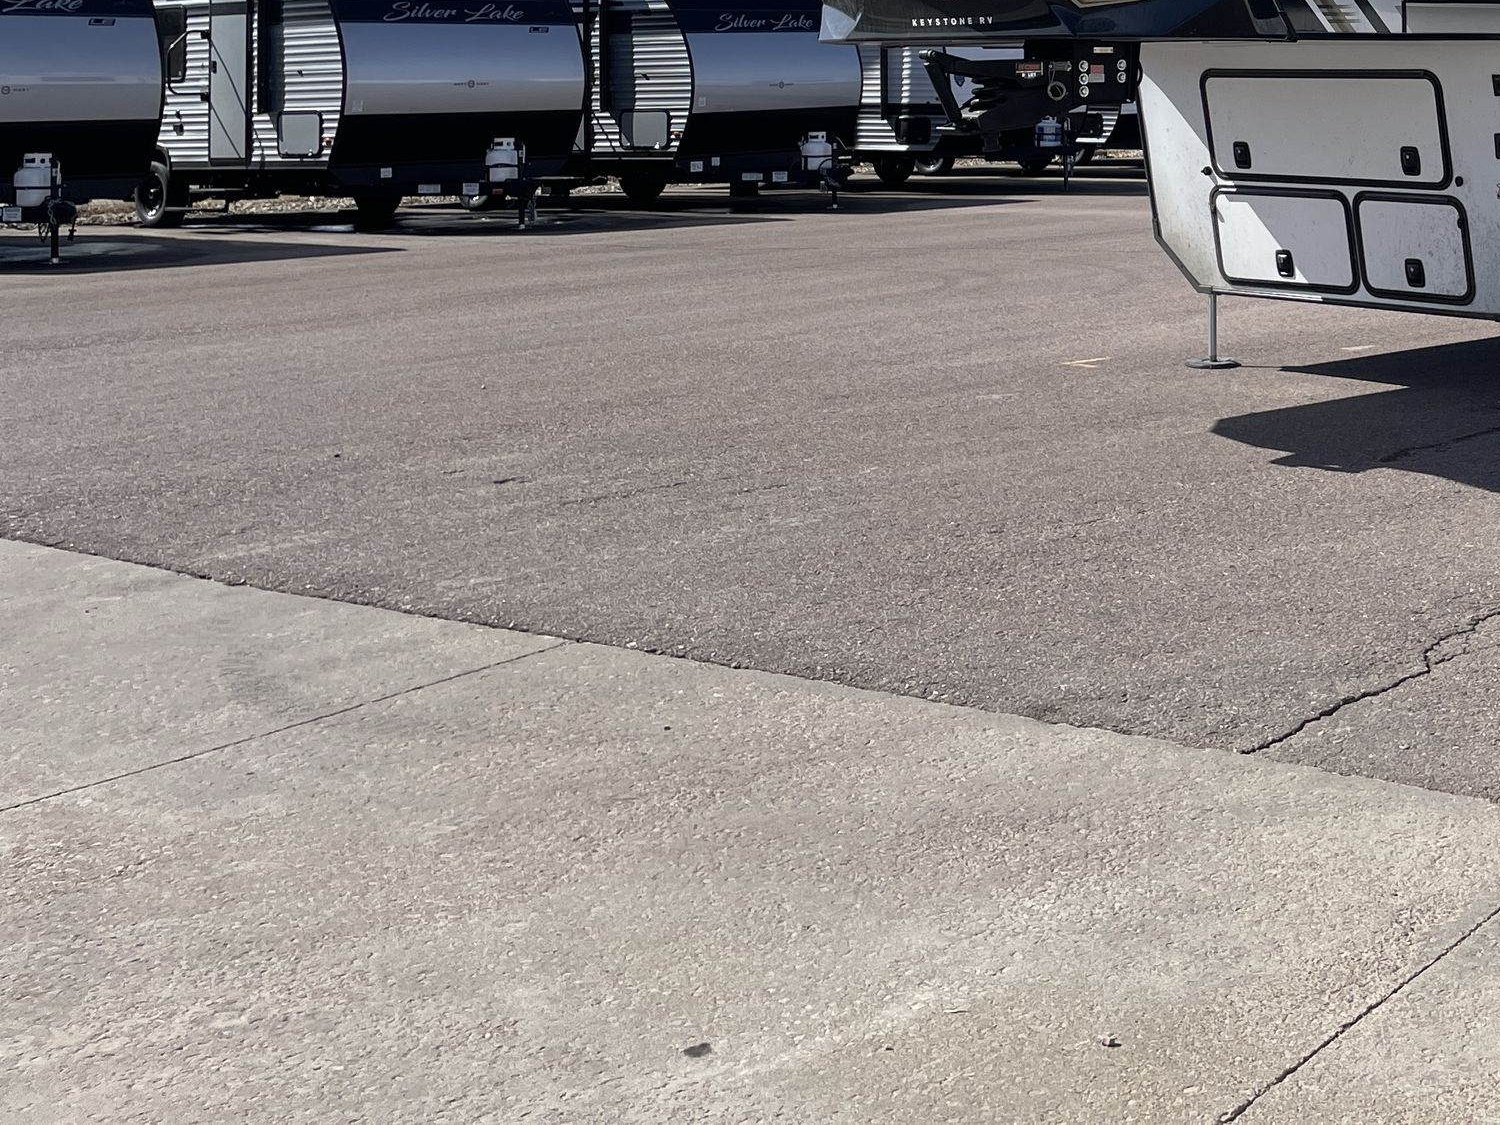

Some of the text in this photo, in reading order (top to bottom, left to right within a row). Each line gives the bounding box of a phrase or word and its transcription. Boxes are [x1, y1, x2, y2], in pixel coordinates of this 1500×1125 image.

[383, 1, 525, 22] Silver Lake
[715, 13, 814, 32] Silver Lake
[912, 16, 993, 27] KEYSTONE RV
